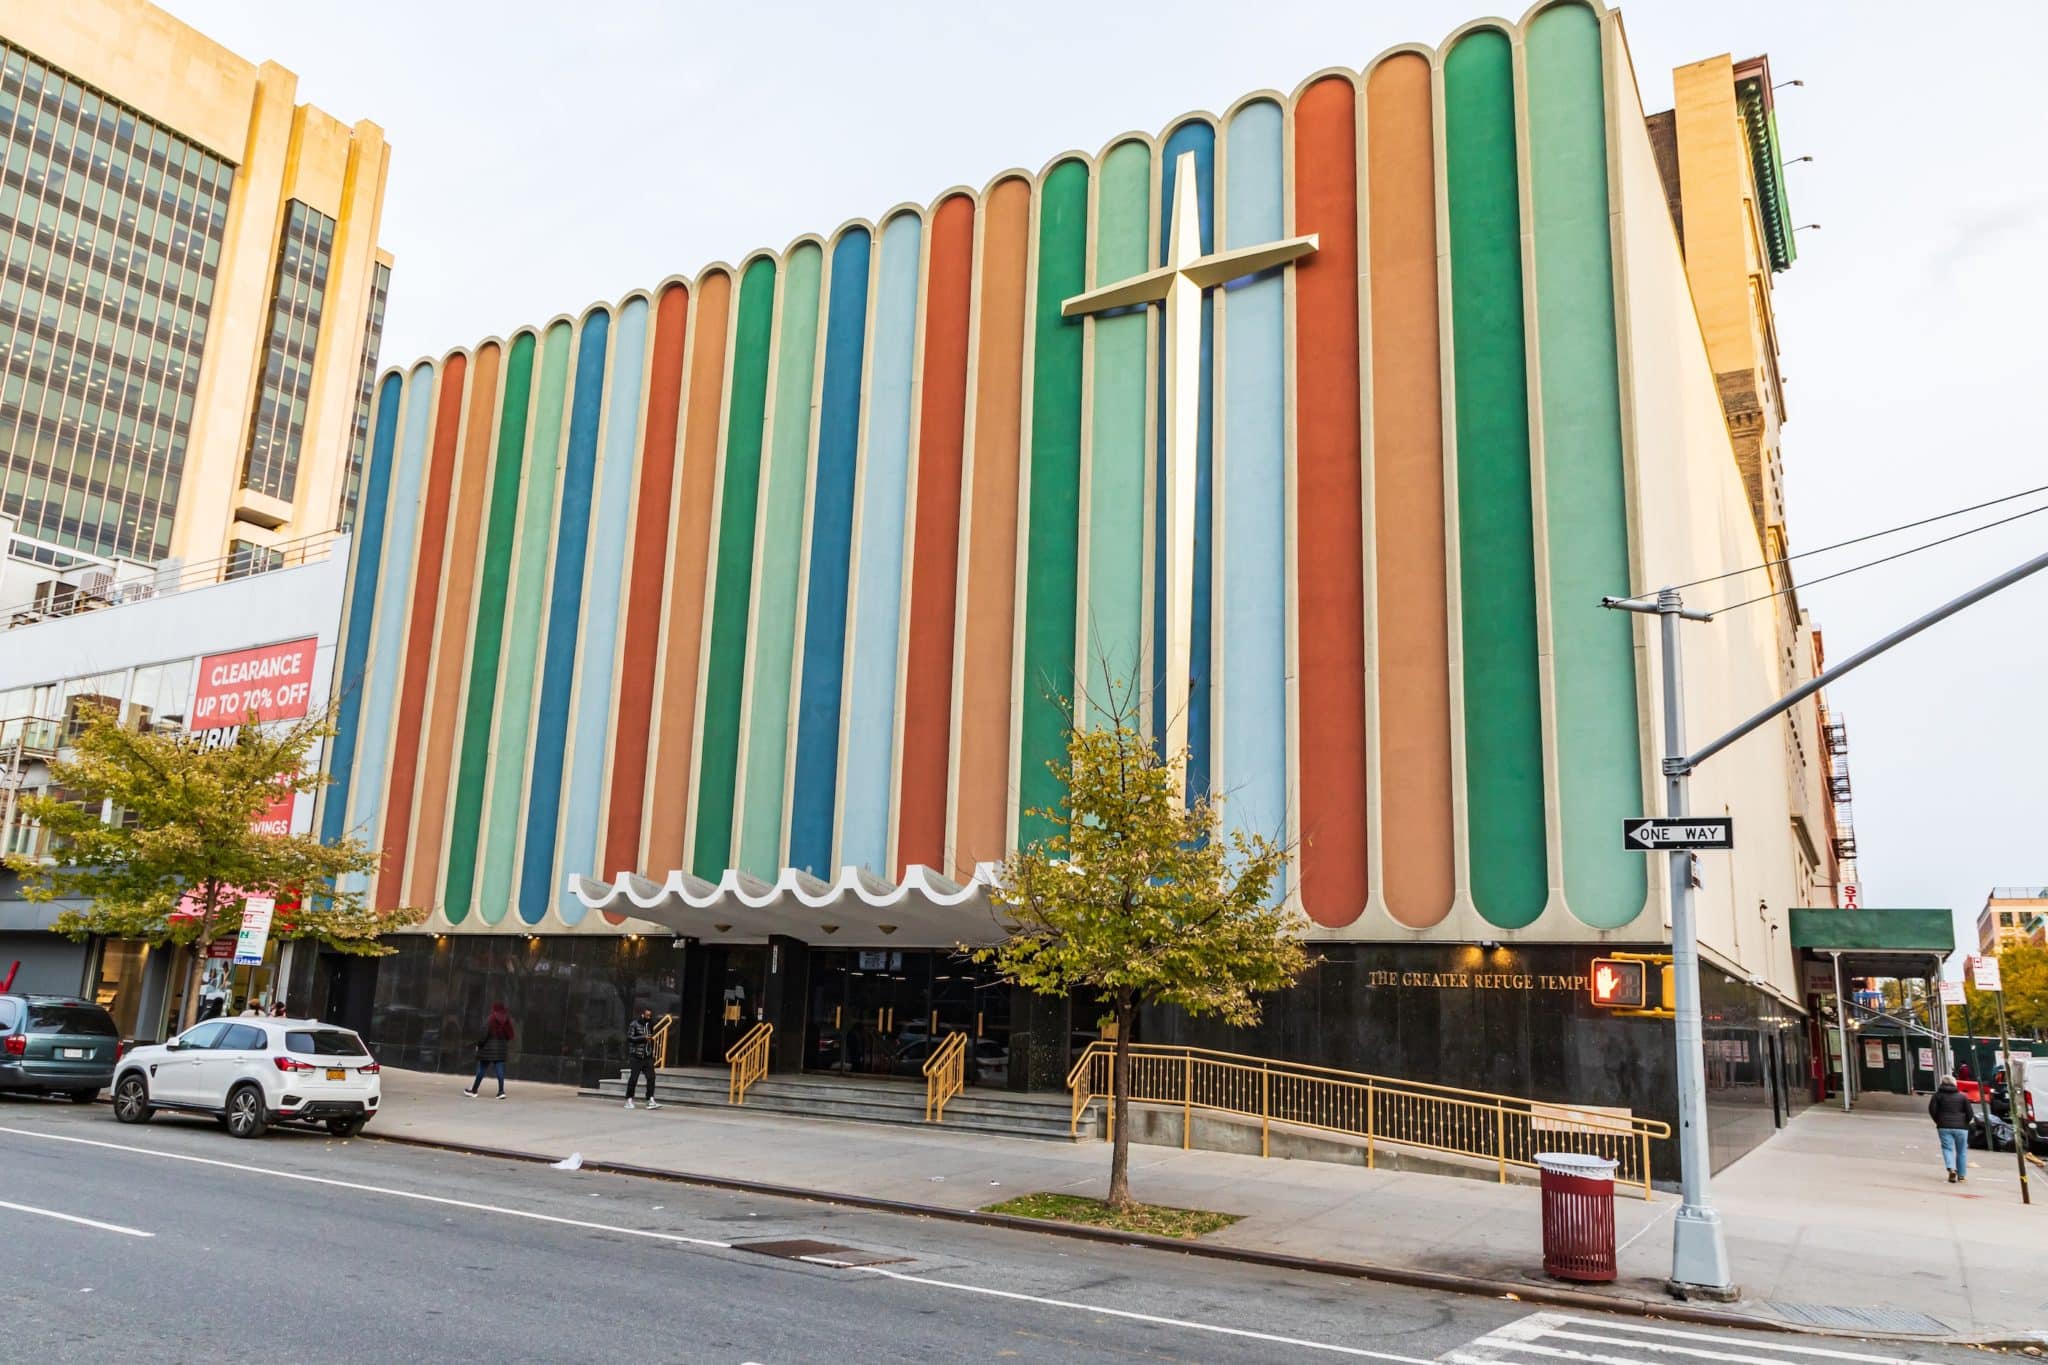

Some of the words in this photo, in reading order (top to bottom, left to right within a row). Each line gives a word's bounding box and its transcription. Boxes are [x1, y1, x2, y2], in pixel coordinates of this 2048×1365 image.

[211, 653, 302, 687] CLEARANCE
[196, 696, 217, 718] UP
[219, 692, 239, 715] TO
[242, 688, 273, 712] 70%
[276, 682, 309, 706] OFF
[1640, 828, 1670, 841] ONE
[1685, 827, 1718, 840] WAY
[1369, 971, 1398, 986] THE
[1402, 972, 1468, 988] GREATER
[1475, 974, 1533, 990] REFUGE
[1540, 975, 1592, 990] TEMPL
